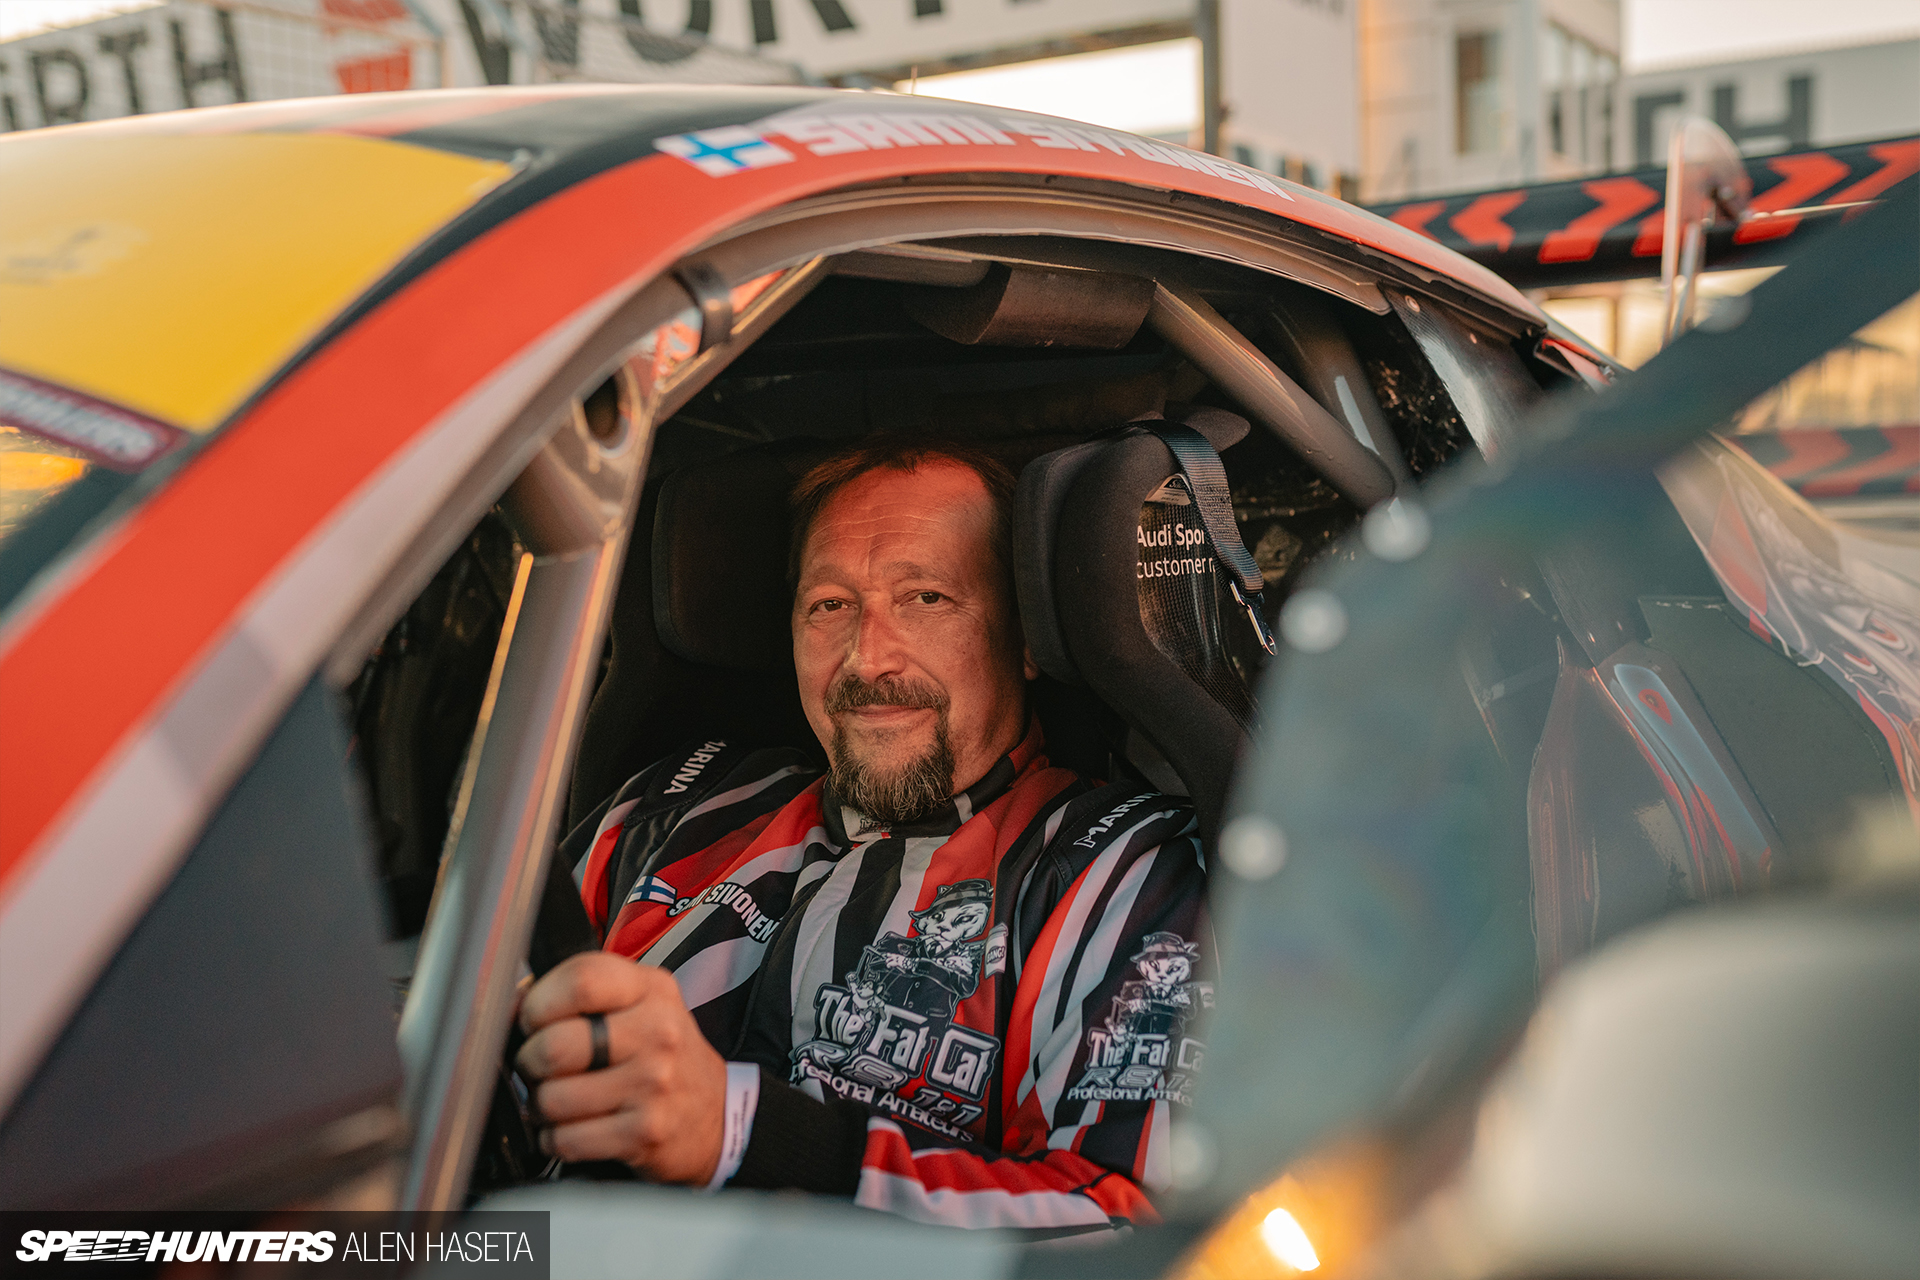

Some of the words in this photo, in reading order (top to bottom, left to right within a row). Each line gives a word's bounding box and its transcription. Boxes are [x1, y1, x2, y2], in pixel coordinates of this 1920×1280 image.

[0, 8, 246, 130] RTH
[1137, 525, 1172, 547] Audi
[1176, 523, 1205, 550] Spor
[1137, 557, 1206, 578] customer
[1073, 792, 1162, 848] MARIN
[704, 883, 780, 941] SIVONEN
[819, 990, 864, 1044] The
[866, 1004, 930, 1071] Fat
[931, 1028, 995, 1095] Cat
[1088, 1031, 1123, 1067] The
[1130, 1034, 1170, 1066] Fat
[1177, 1037, 1207, 1072] Ca
[877, 1091, 974, 1143] Amateurs
